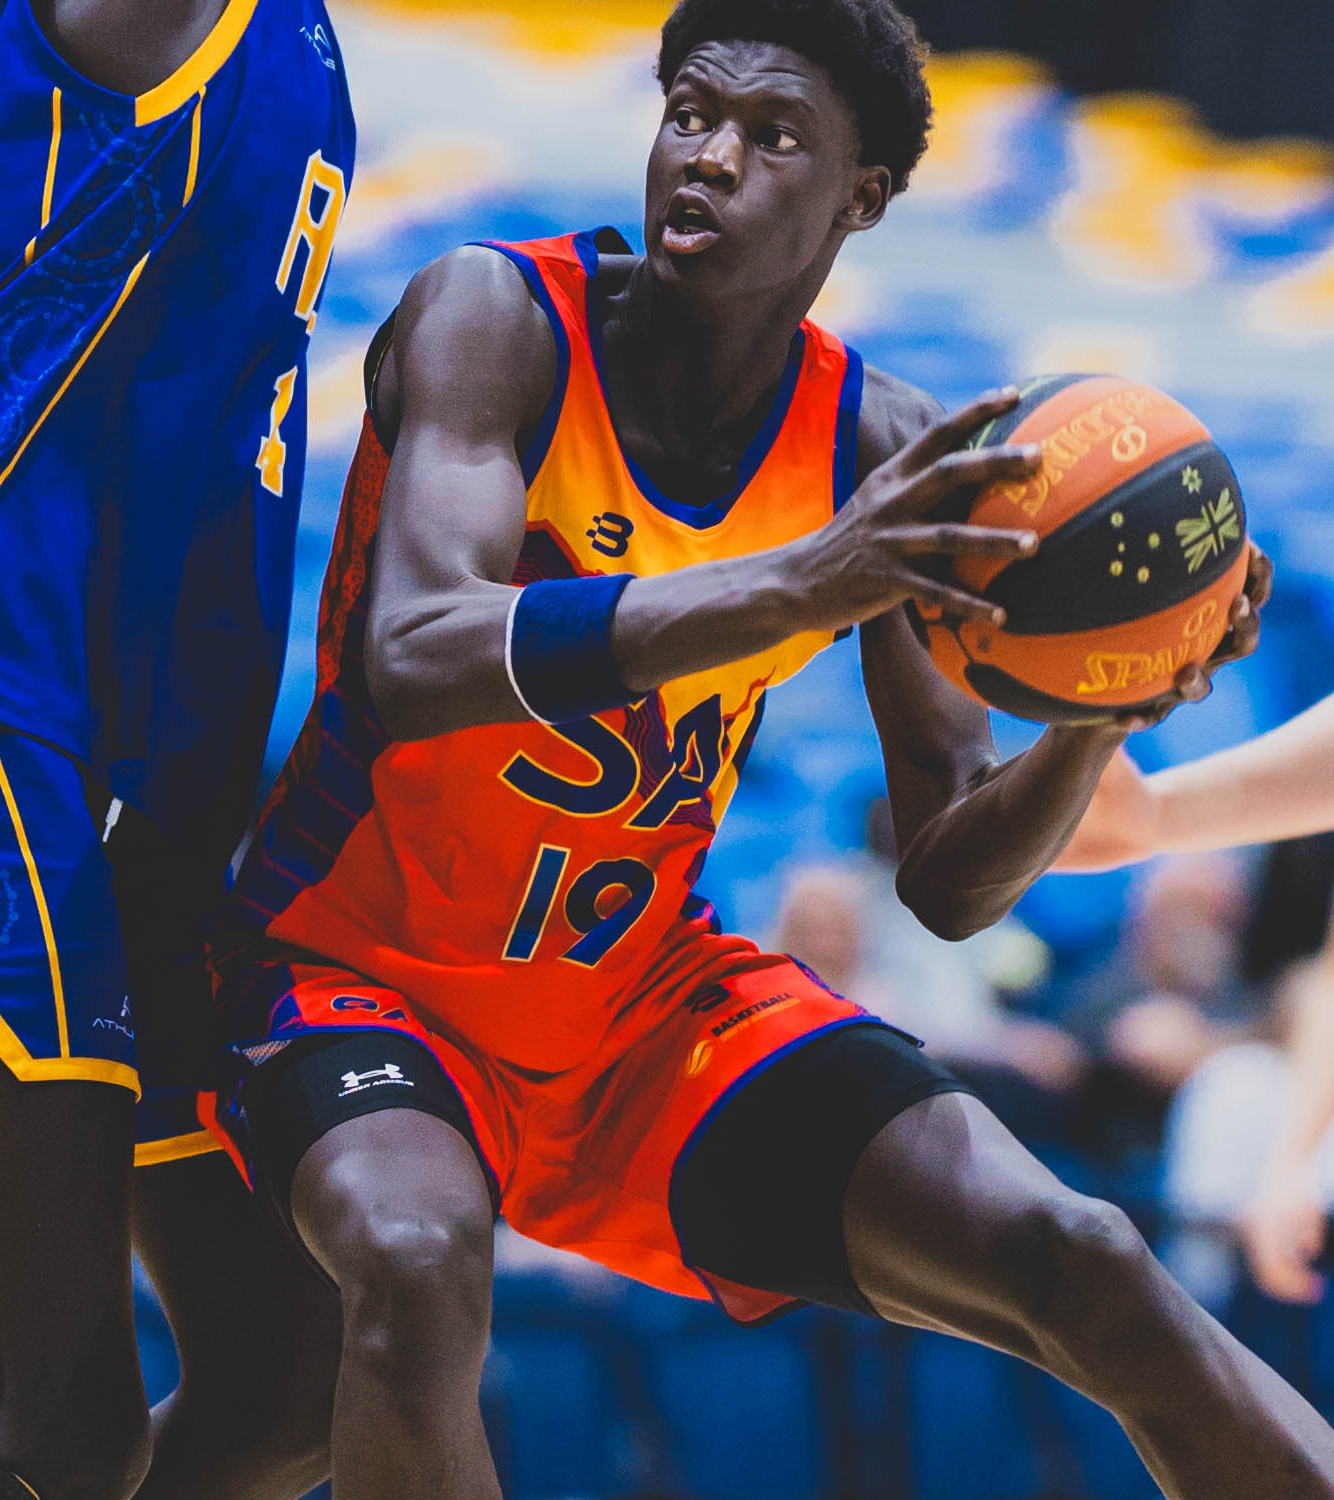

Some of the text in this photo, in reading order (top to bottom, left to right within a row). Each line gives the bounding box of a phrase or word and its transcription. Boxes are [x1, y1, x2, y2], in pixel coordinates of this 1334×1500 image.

[496, 690, 729, 832] SA
[500, 842, 658, 970] 19
[710, 992, 793, 1037] BASKETBALL
